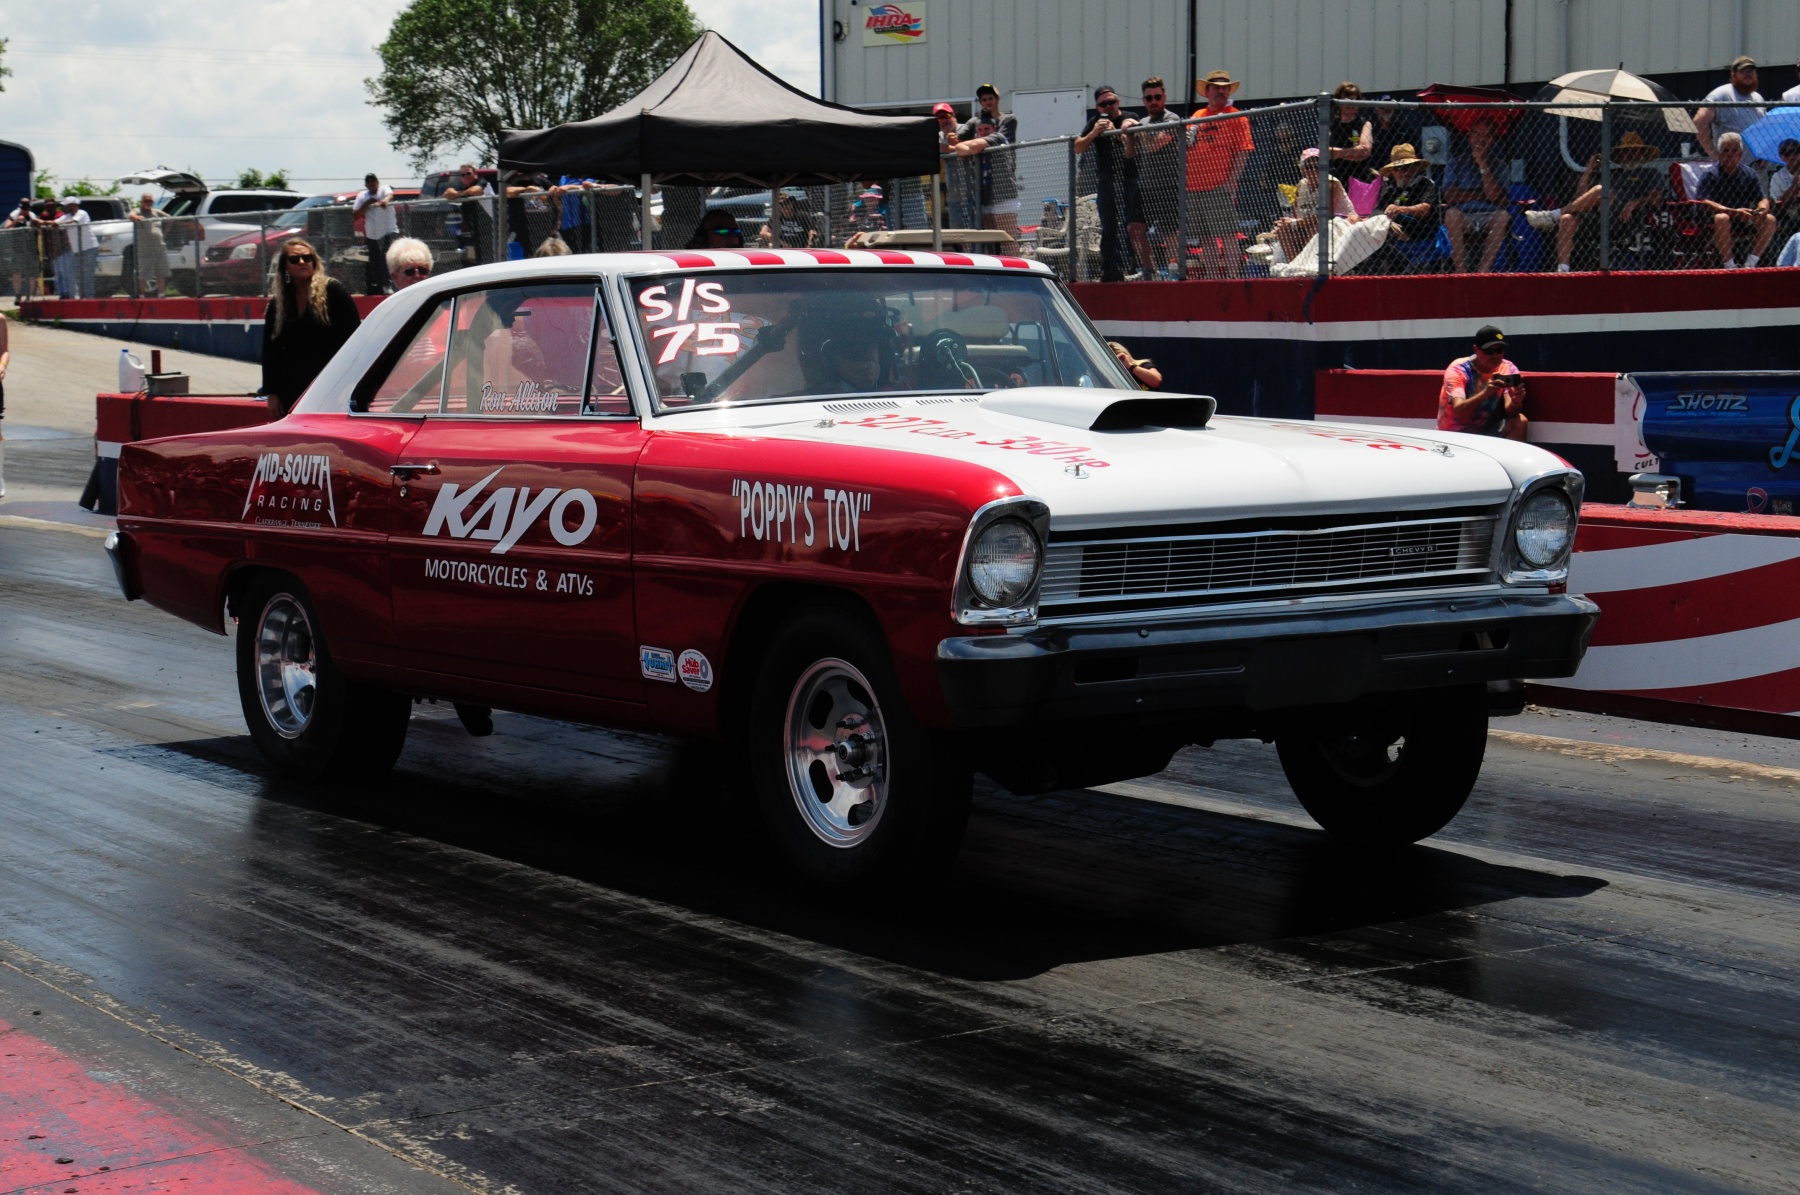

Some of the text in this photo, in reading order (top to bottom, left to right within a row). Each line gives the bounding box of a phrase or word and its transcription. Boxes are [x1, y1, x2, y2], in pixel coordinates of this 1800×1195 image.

[865, 13, 913, 28] IHRA
[638, 278, 731, 322] S/S
[651, 322, 741, 365] 75
[479, 381, 559, 412] Ron Allison
[257, 494, 322, 511] RACING
[422, 465, 598, 555] KAYO
[1395, 546, 1426, 554] CHEVY
[425, 558, 594, 596] MOTORCYCLES & ATVs
[682, 665, 700, 675] Saver
[685, 658, 699, 668] Hub
